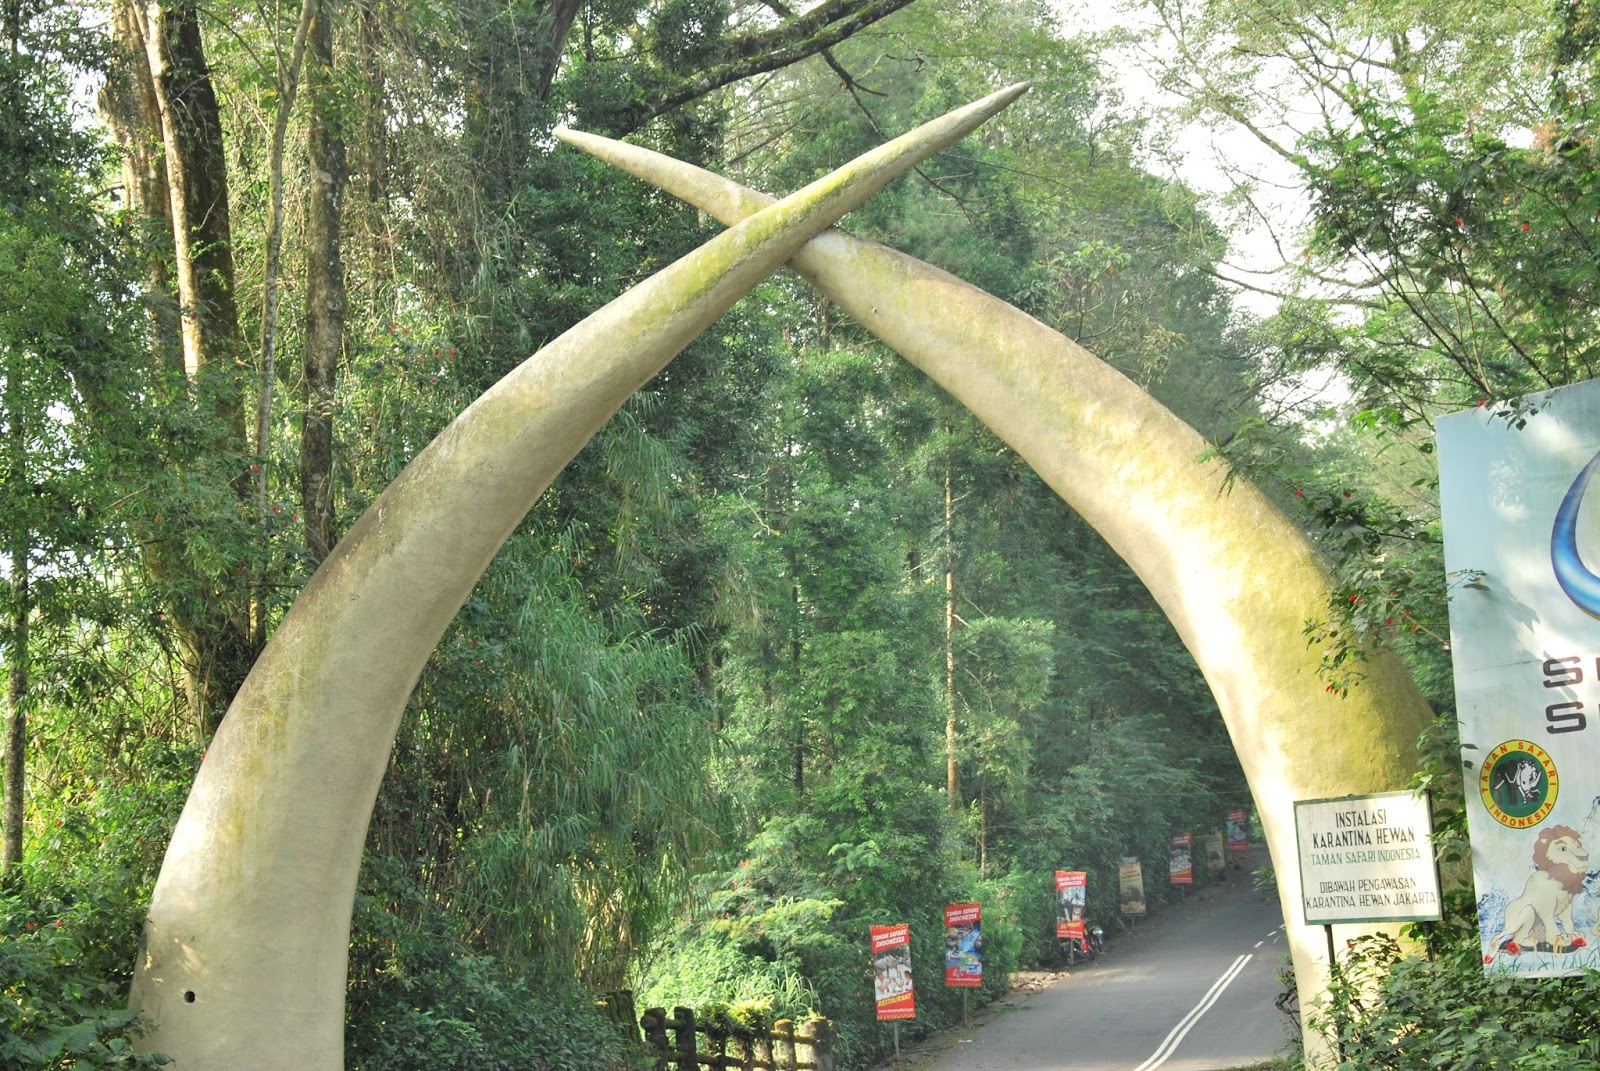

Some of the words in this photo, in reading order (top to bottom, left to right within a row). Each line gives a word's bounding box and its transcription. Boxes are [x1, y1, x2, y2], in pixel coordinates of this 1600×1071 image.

[1543, 656, 1600, 688] S
[1545, 701, 1600, 735] S
[1481, 745, 1508, 793] TAMAN
[1518, 741, 1557, 786] SAFARI
[1335, 808, 1387, 828] INSTALASI
[1489, 802, 1552, 827] INDONESIA
[1312, 829, 1372, 849] KARANTINA
[1376, 826, 1415, 845] HEWAN
[1311, 852, 1343, 866] TAMAN
[1346, 850, 1376, 864] SAFARI
[1377, 848, 1421, 862] INDONESIA
[1319, 879, 1355, 894] DIBAWAH
[1358, 877, 1416, 892] PENGAWASAN
[1306, 895, 1356, 909] KARANTINA
[1359, 894, 1391, 907] HEWAN
[1393, 891, 1436, 905] JAKARTA
[872, 932, 889, 941] TAMAN
[889, 929, 907, 938] SAFARI
[875, 936, 905, 948] INDONESIA
[877, 993, 912, 1007] RESTAURANT
